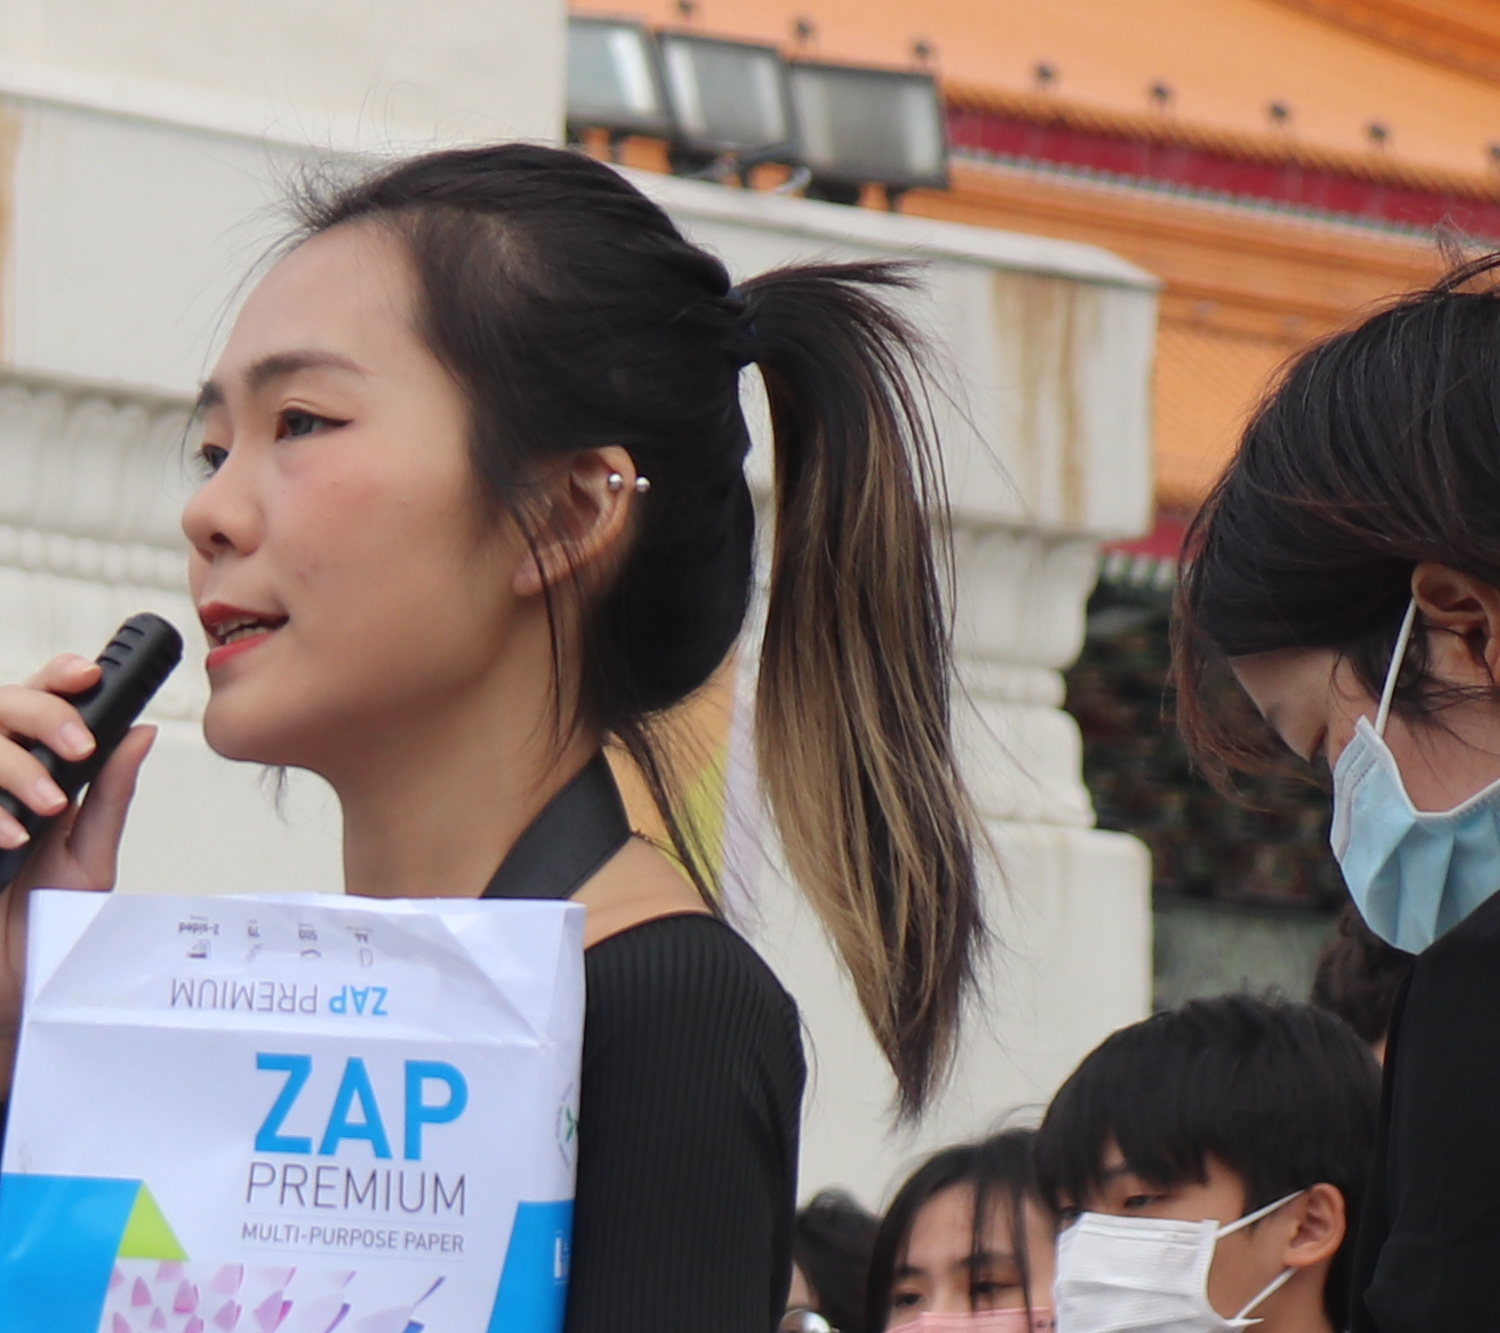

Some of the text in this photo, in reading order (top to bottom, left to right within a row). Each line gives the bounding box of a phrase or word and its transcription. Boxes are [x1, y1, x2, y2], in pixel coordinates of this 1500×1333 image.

[170, 978, 388, 1016] ZAP PREMIUM
[254, 1052, 469, 1161] ZAP
[246, 1161, 465, 1216] PREMIUM
[242, 1222, 464, 1252] MULTI-PURPOSE PAPER
